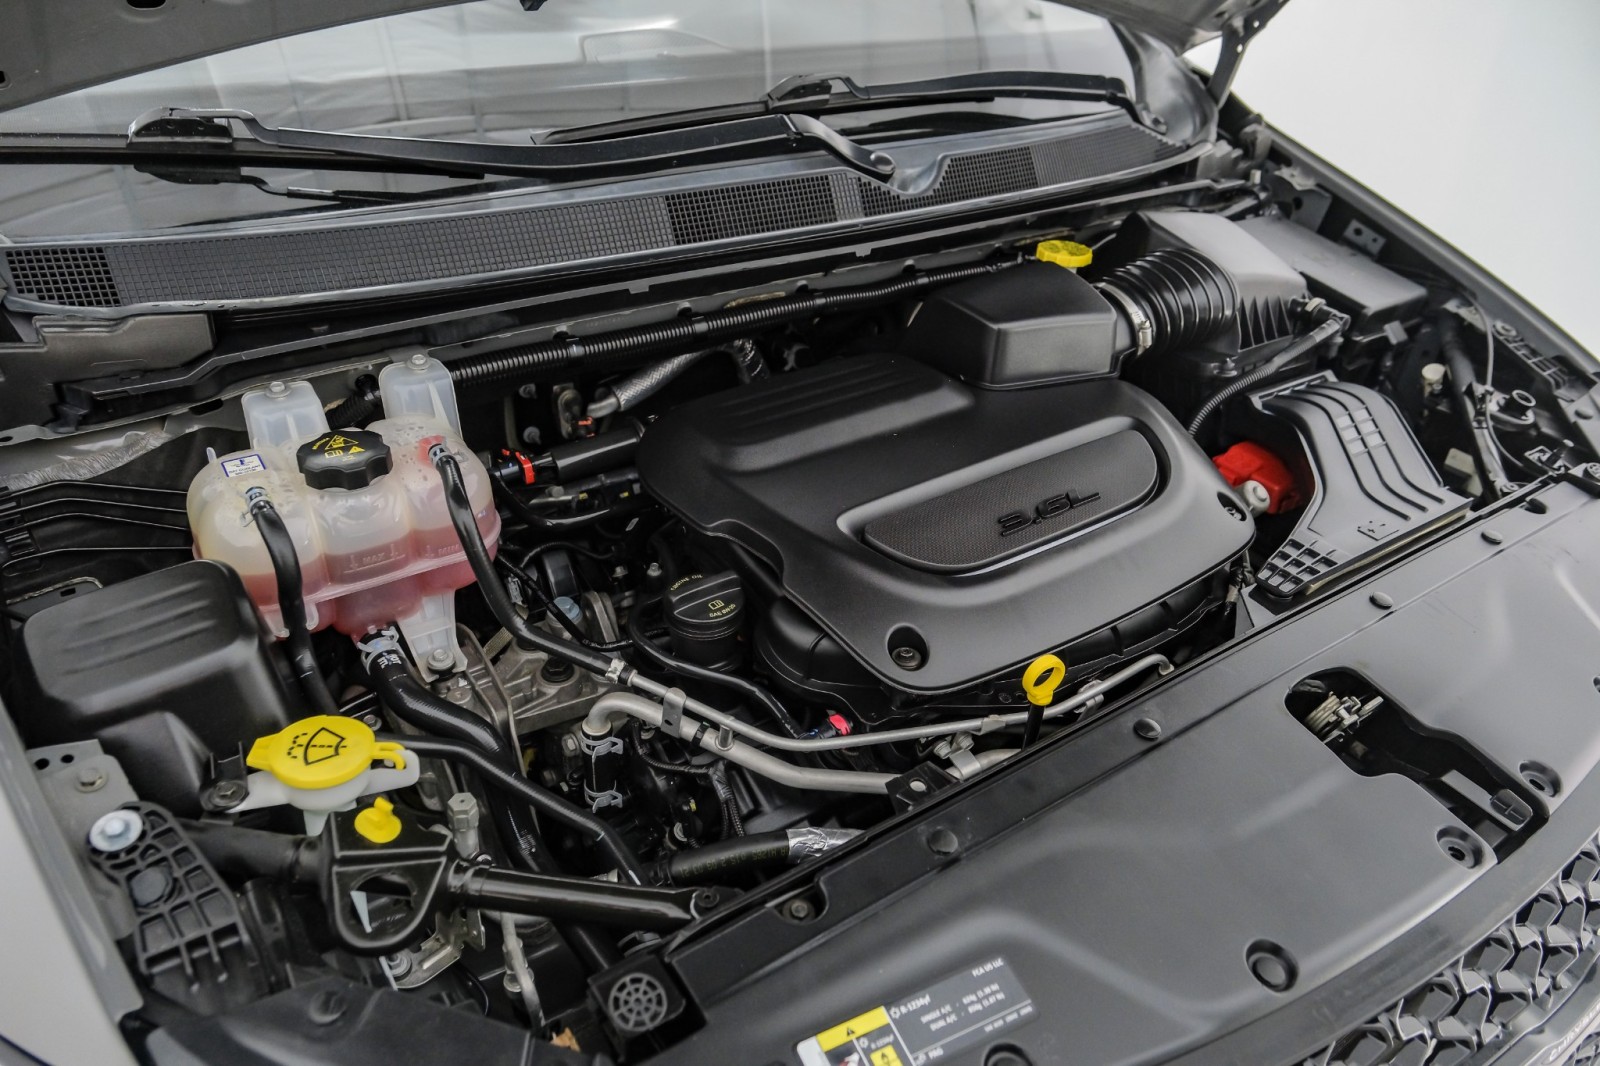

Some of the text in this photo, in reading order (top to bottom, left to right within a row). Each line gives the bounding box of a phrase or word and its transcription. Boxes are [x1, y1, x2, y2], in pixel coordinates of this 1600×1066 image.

[997, 488, 1101, 537] 3.6L
[362, 552, 385, 564] MAX
[670, 577, 690, 591] ENGINE
[971, 957, 1004, 977] FCA US LLC
[900, 993, 931, 1015] R-1234yf
